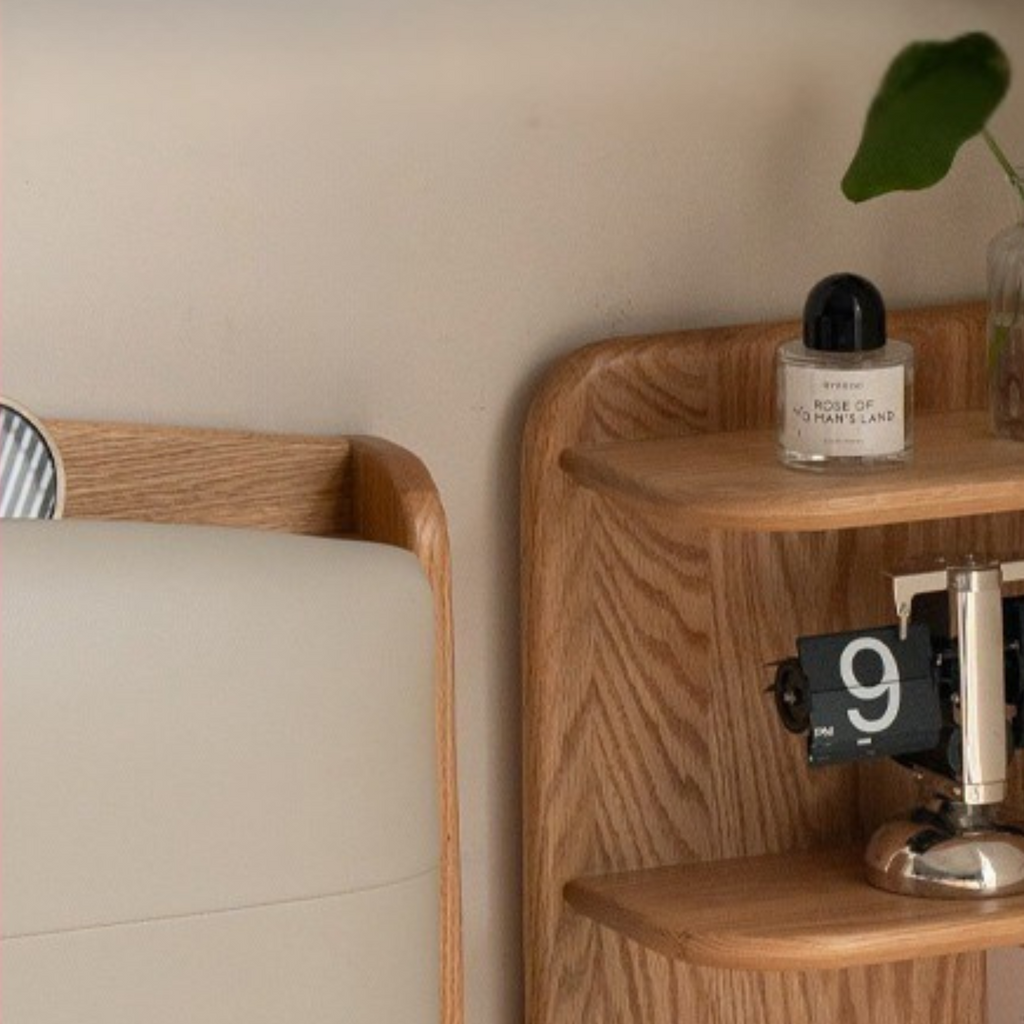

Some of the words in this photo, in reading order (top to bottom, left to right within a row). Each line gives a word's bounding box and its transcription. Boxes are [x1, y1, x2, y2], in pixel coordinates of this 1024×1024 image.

[813, 400, 850, 412] ROSE
[854, 400, 875, 412] OF
[813, 412, 855, 424] MAN'S
[839, 636, 901, 733] 9
